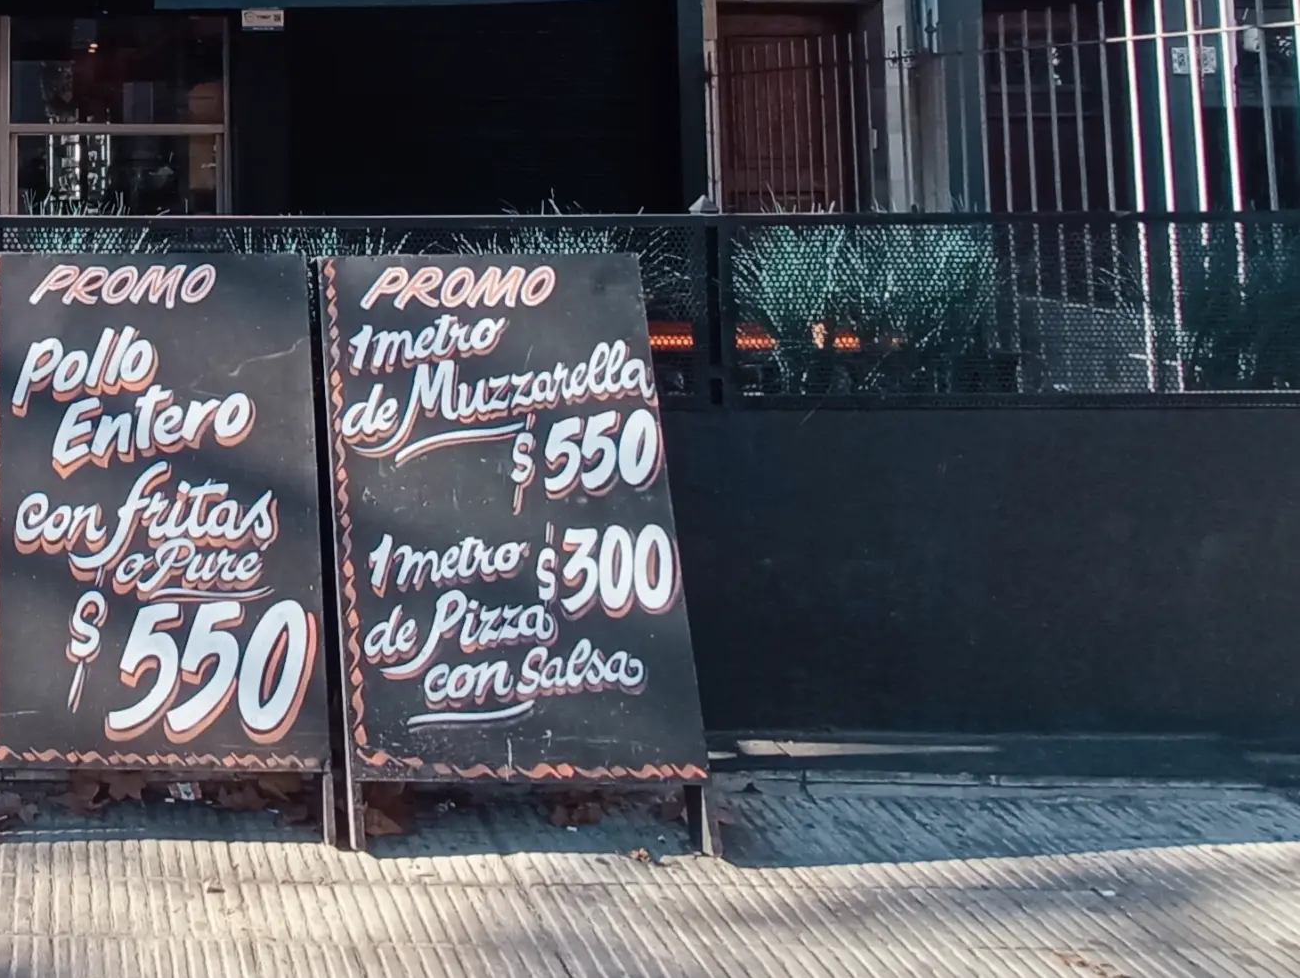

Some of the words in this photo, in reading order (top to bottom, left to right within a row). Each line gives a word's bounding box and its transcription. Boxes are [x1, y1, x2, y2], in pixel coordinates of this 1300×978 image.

[29, 264, 216, 309] PROMO
[360, 265, 556, 310] PROMO
[11, 325, 159, 417] Pollo
[371, 314, 510, 374] metro
[341, 384, 398, 443] de
[352, 339, 658, 458] Muzzarella
[52, 385, 256, 479] Entero
[393, 536, 530, 592] metro
[364, 604, 417, 665] de
[380, 589, 557, 678] Pizza
